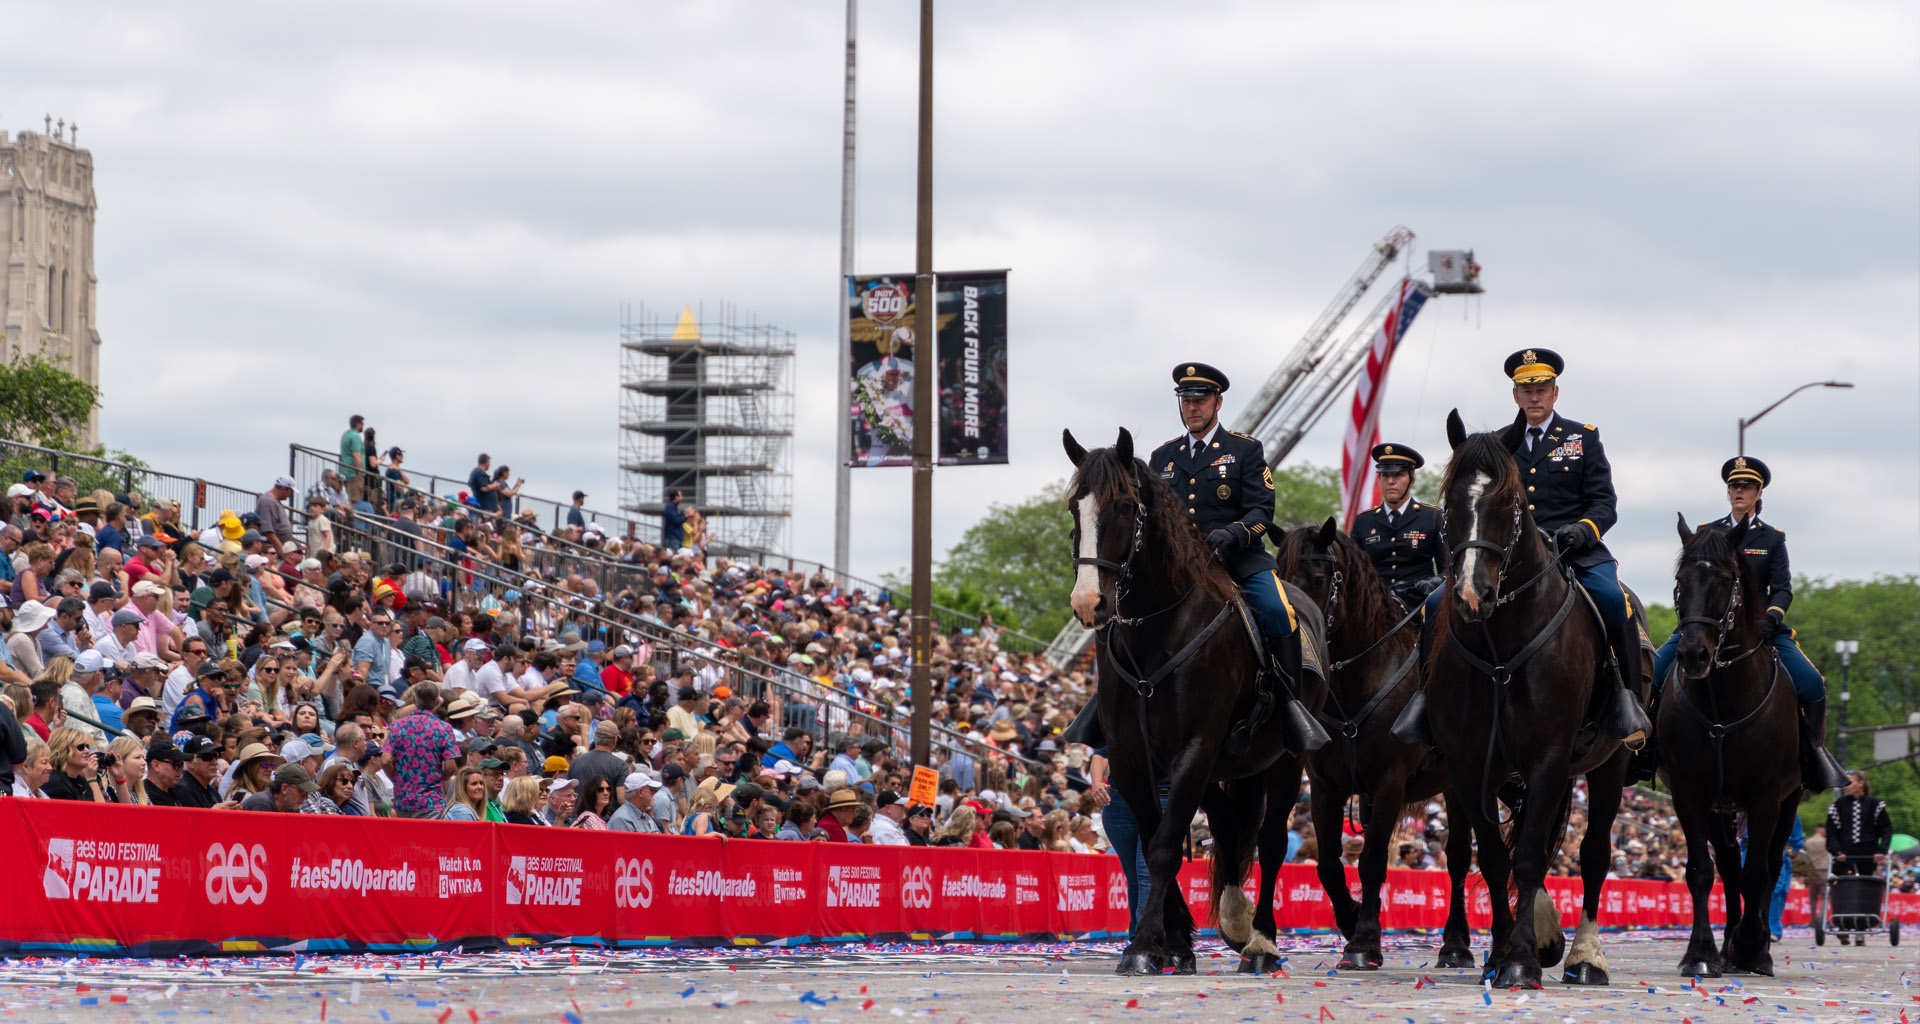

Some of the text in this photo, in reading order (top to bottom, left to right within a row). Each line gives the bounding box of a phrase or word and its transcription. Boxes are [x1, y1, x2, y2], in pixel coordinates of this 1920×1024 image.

[868, 297, 902, 312] 500
[875, 290, 894, 298] INDY
[964, 286, 979, 438] BACK FOUR MORE
[76, 840, 161, 862] aes 500 FESTIVAL
[439, 856, 462, 872] Watch
[463, 856, 471, 871] it
[527, 856, 583, 873] aes 500 FESTIVAL
[73, 861, 160, 903] PARADE
[205, 842, 268, 905] aes
[290, 857, 416, 897] #aes500parade
[615, 857, 653, 909] aes
[668, 869, 756, 902] #aes500parade
[773, 868, 802, 881] Watch it on
[841, 866, 881, 879] aes 500 FESTIVAL
[525, 873, 582, 906] PARADE
[781, 887, 796, 900] WTHR
[840, 880, 880, 907] PARADE
[902, 865, 932, 909] aes
[942, 874, 1006, 902] #aes500parade
[1067, 888, 1096, 911] PARADE
[1109, 871, 1129, 910] aes
